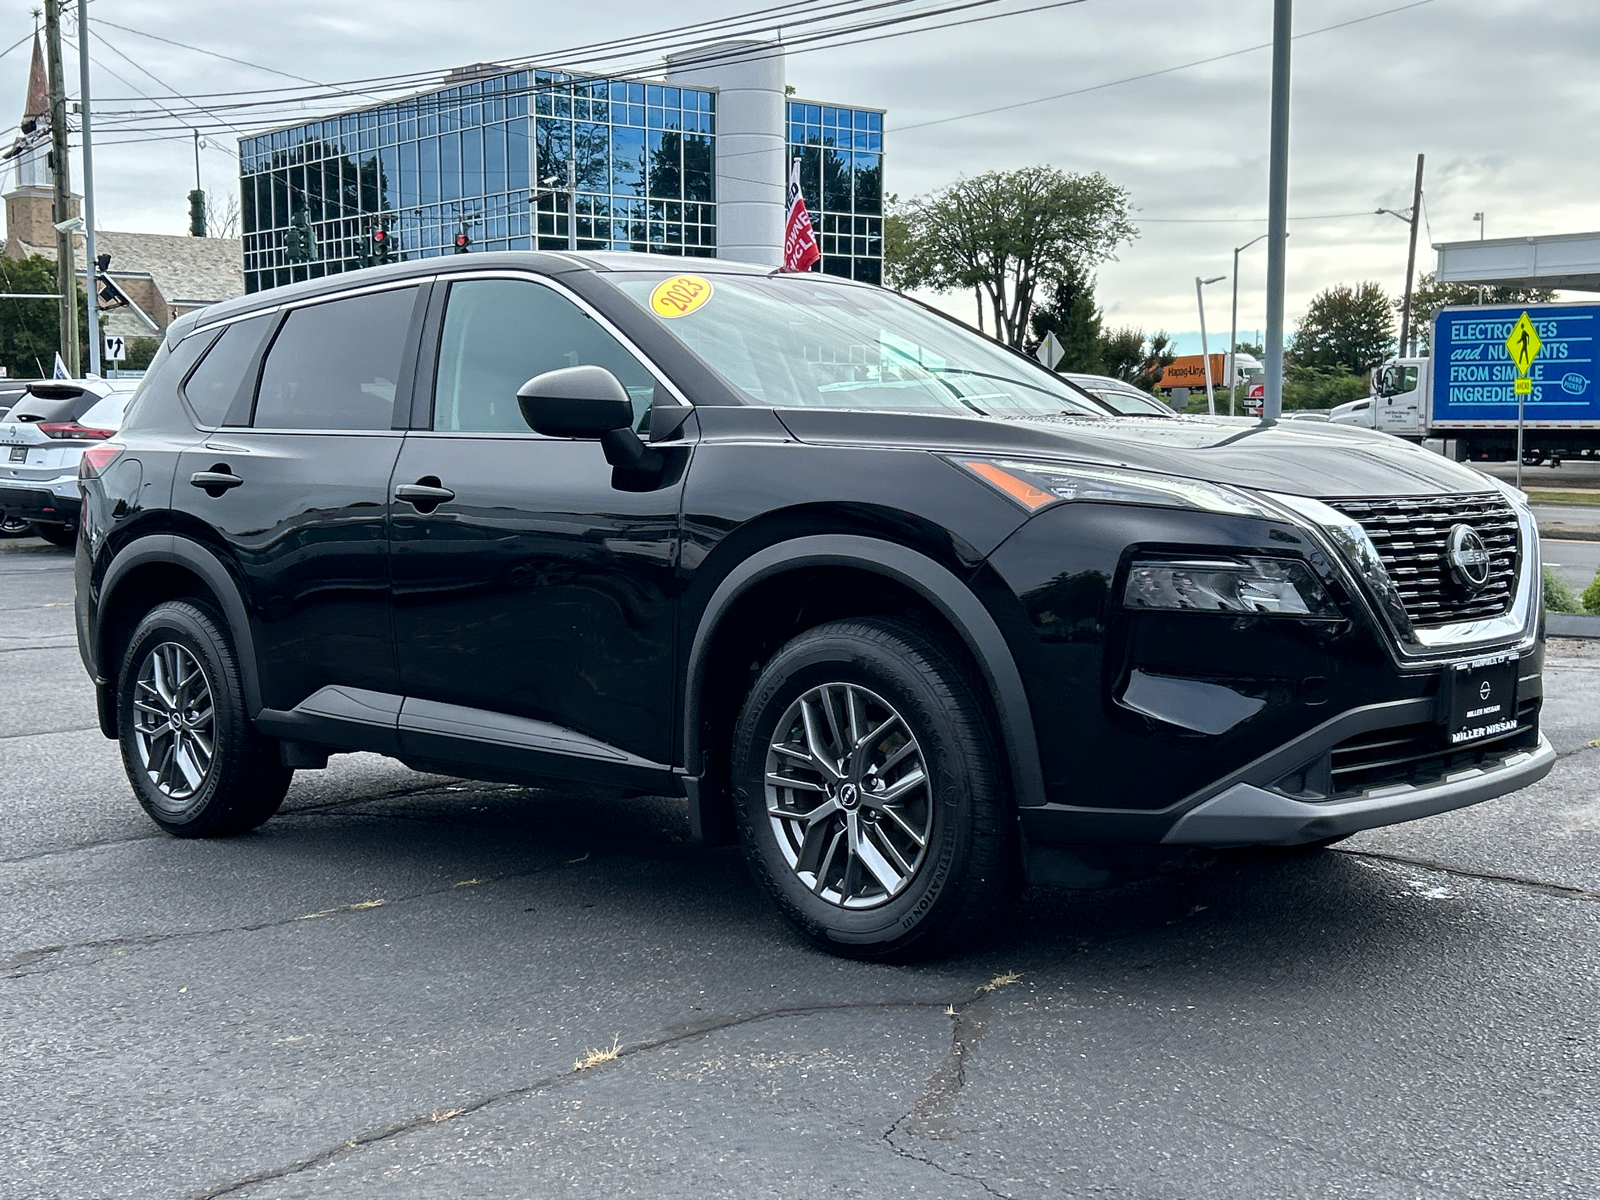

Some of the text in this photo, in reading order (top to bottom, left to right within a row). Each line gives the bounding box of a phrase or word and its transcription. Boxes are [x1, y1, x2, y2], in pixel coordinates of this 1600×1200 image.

[786, 211, 810, 255] OWNE
[660, 278, 704, 312] 2023
[1451, 322, 1558, 340] ELECTROTES
[1450, 343, 1569, 360] and NUNTS
[1450, 365, 1544, 382] FROM SIMLE
[1452, 719, 1518, 743] MILLER NISSAN
